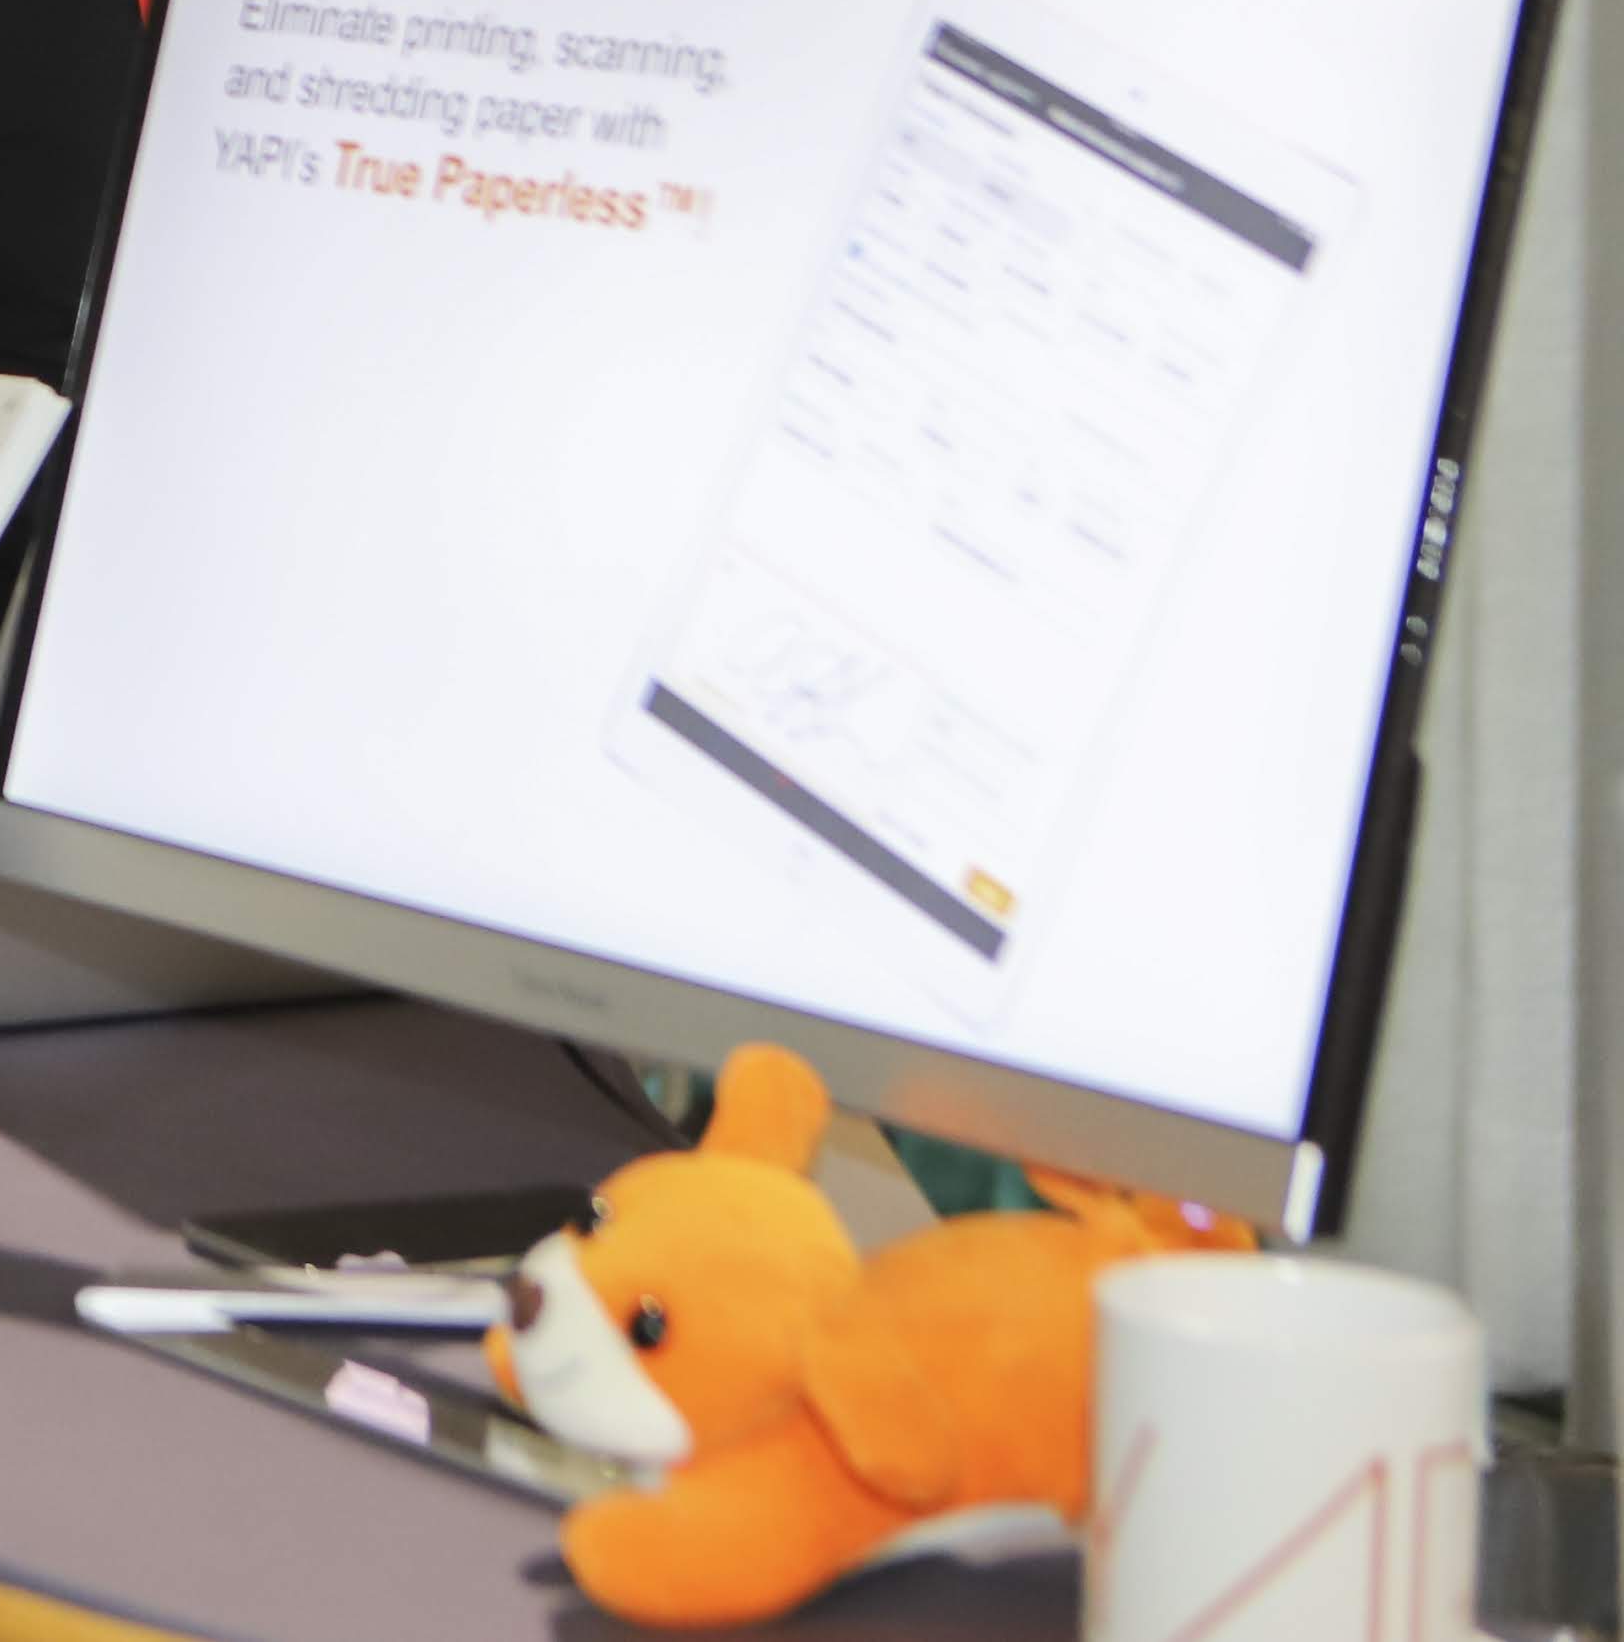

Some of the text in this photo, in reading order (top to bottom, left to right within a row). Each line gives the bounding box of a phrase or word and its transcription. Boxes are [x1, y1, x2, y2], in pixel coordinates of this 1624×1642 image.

[401, 8, 542, 73] printing,
[223, 59, 668, 149] and shredding paper with
[335, 140, 422, 200] True
[434, 155, 649, 231] Paperless
